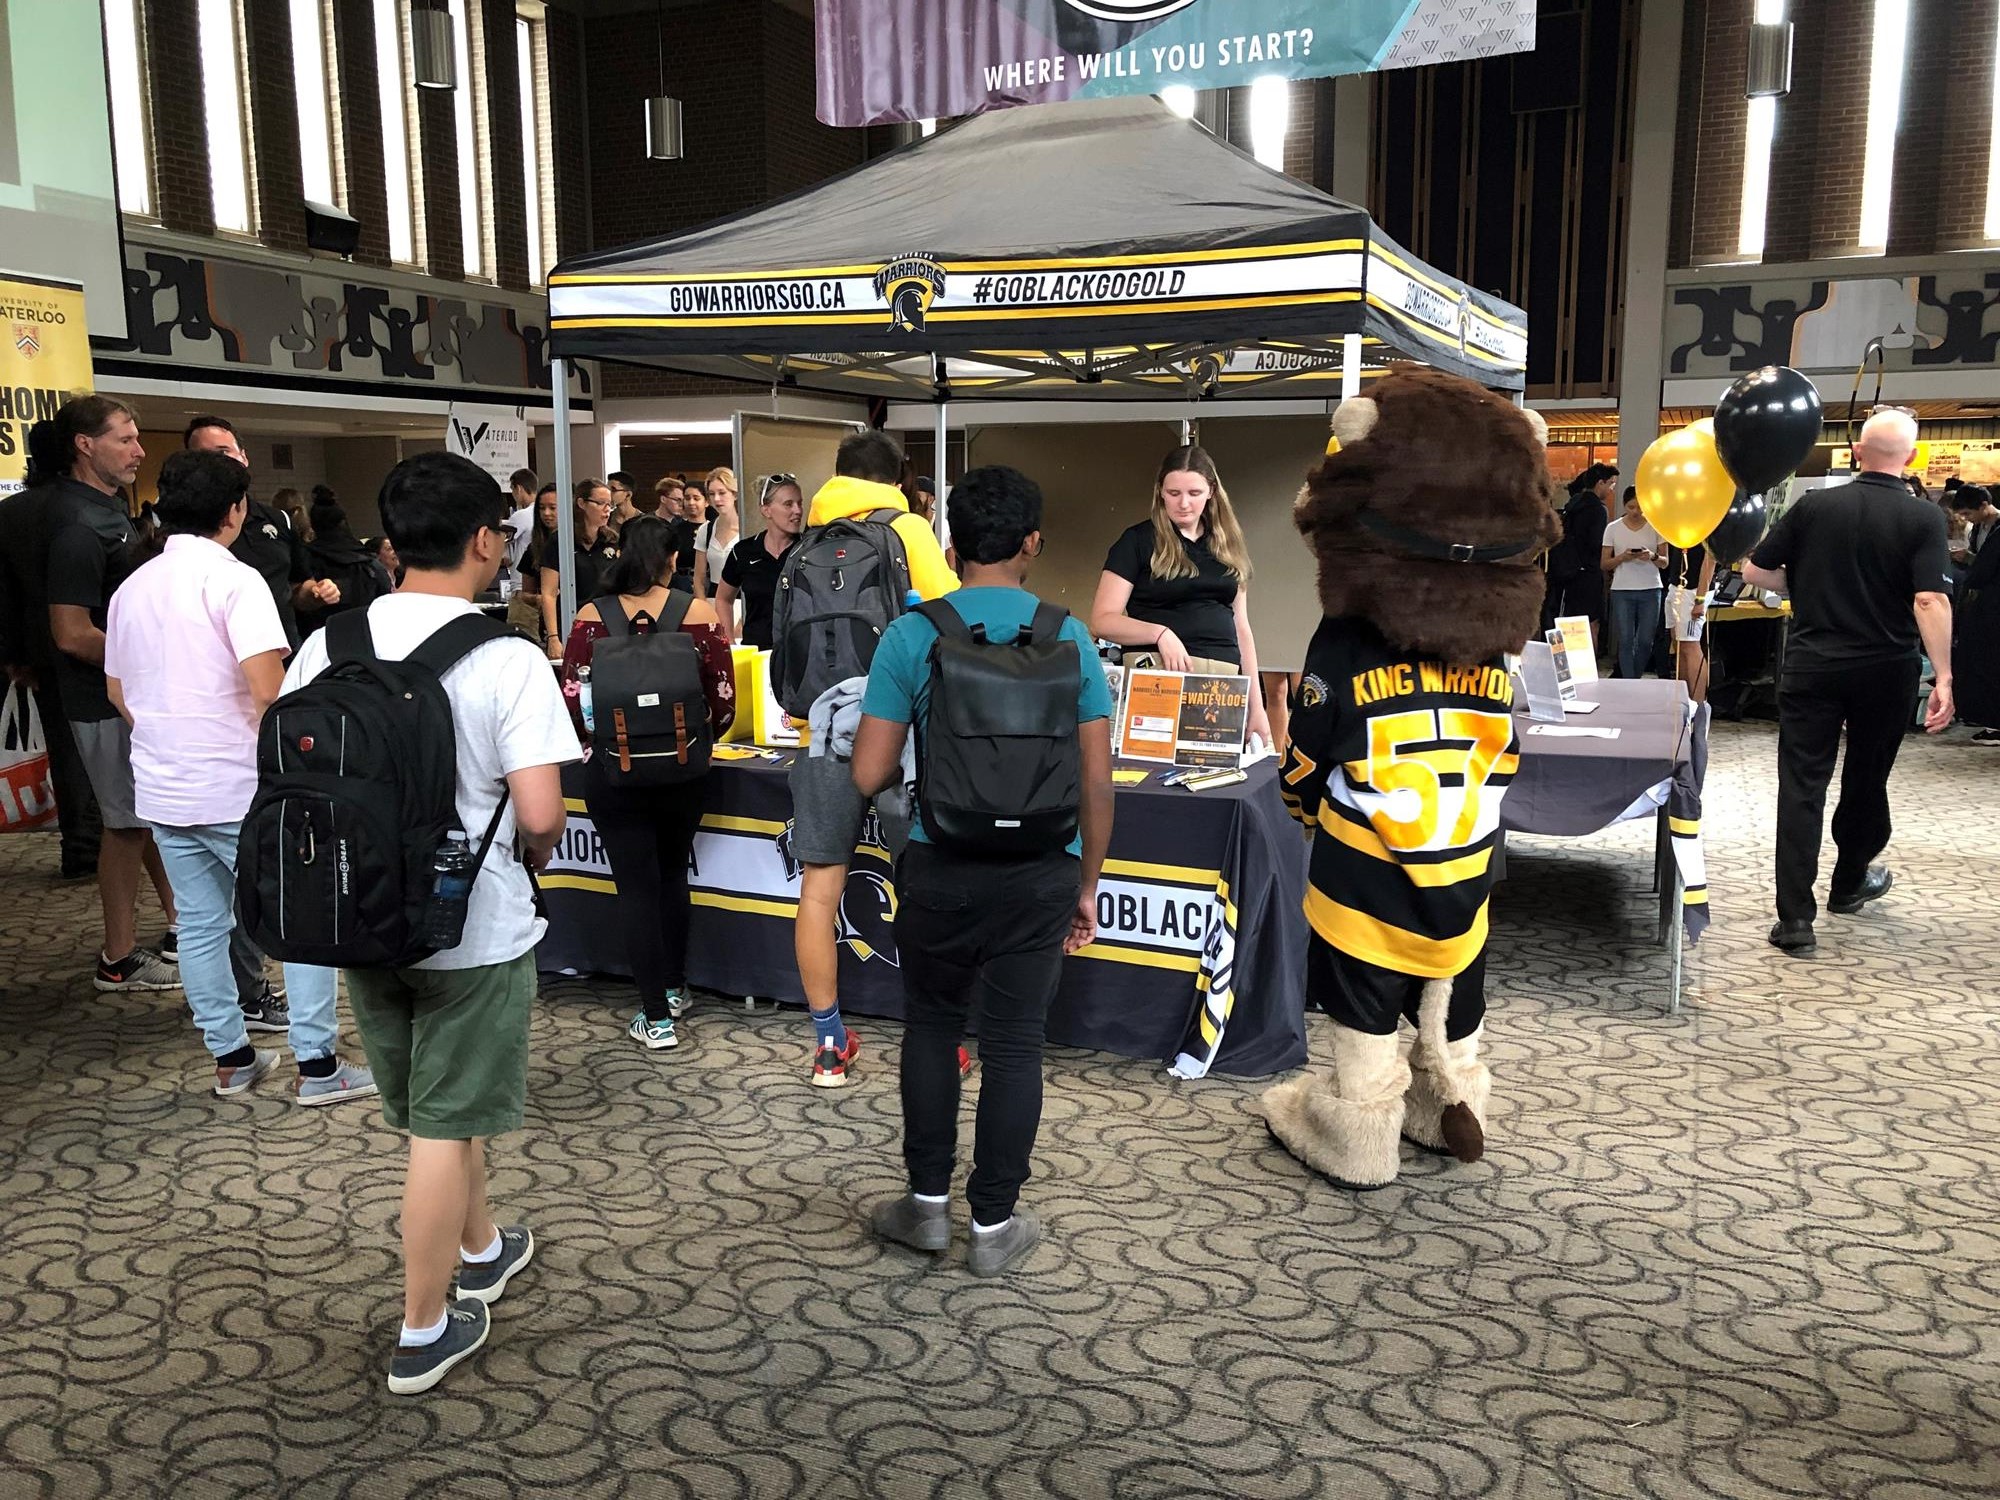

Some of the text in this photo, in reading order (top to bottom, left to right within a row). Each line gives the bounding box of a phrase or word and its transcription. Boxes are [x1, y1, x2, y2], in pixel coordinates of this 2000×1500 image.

[984, 28, 1314, 92] WHERE WILL YOU START?
[670, 281, 845, 312] GOWARRIORSGO.CA
[872, 262, 946, 300] WARRIORS
[973, 270, 1186, 304] #GOBLACKGOGOLD
[1187, 692, 1241, 707] WATERLOO
[1352, 664, 1416, 707] KING
[1366, 707, 1514, 852] 57
